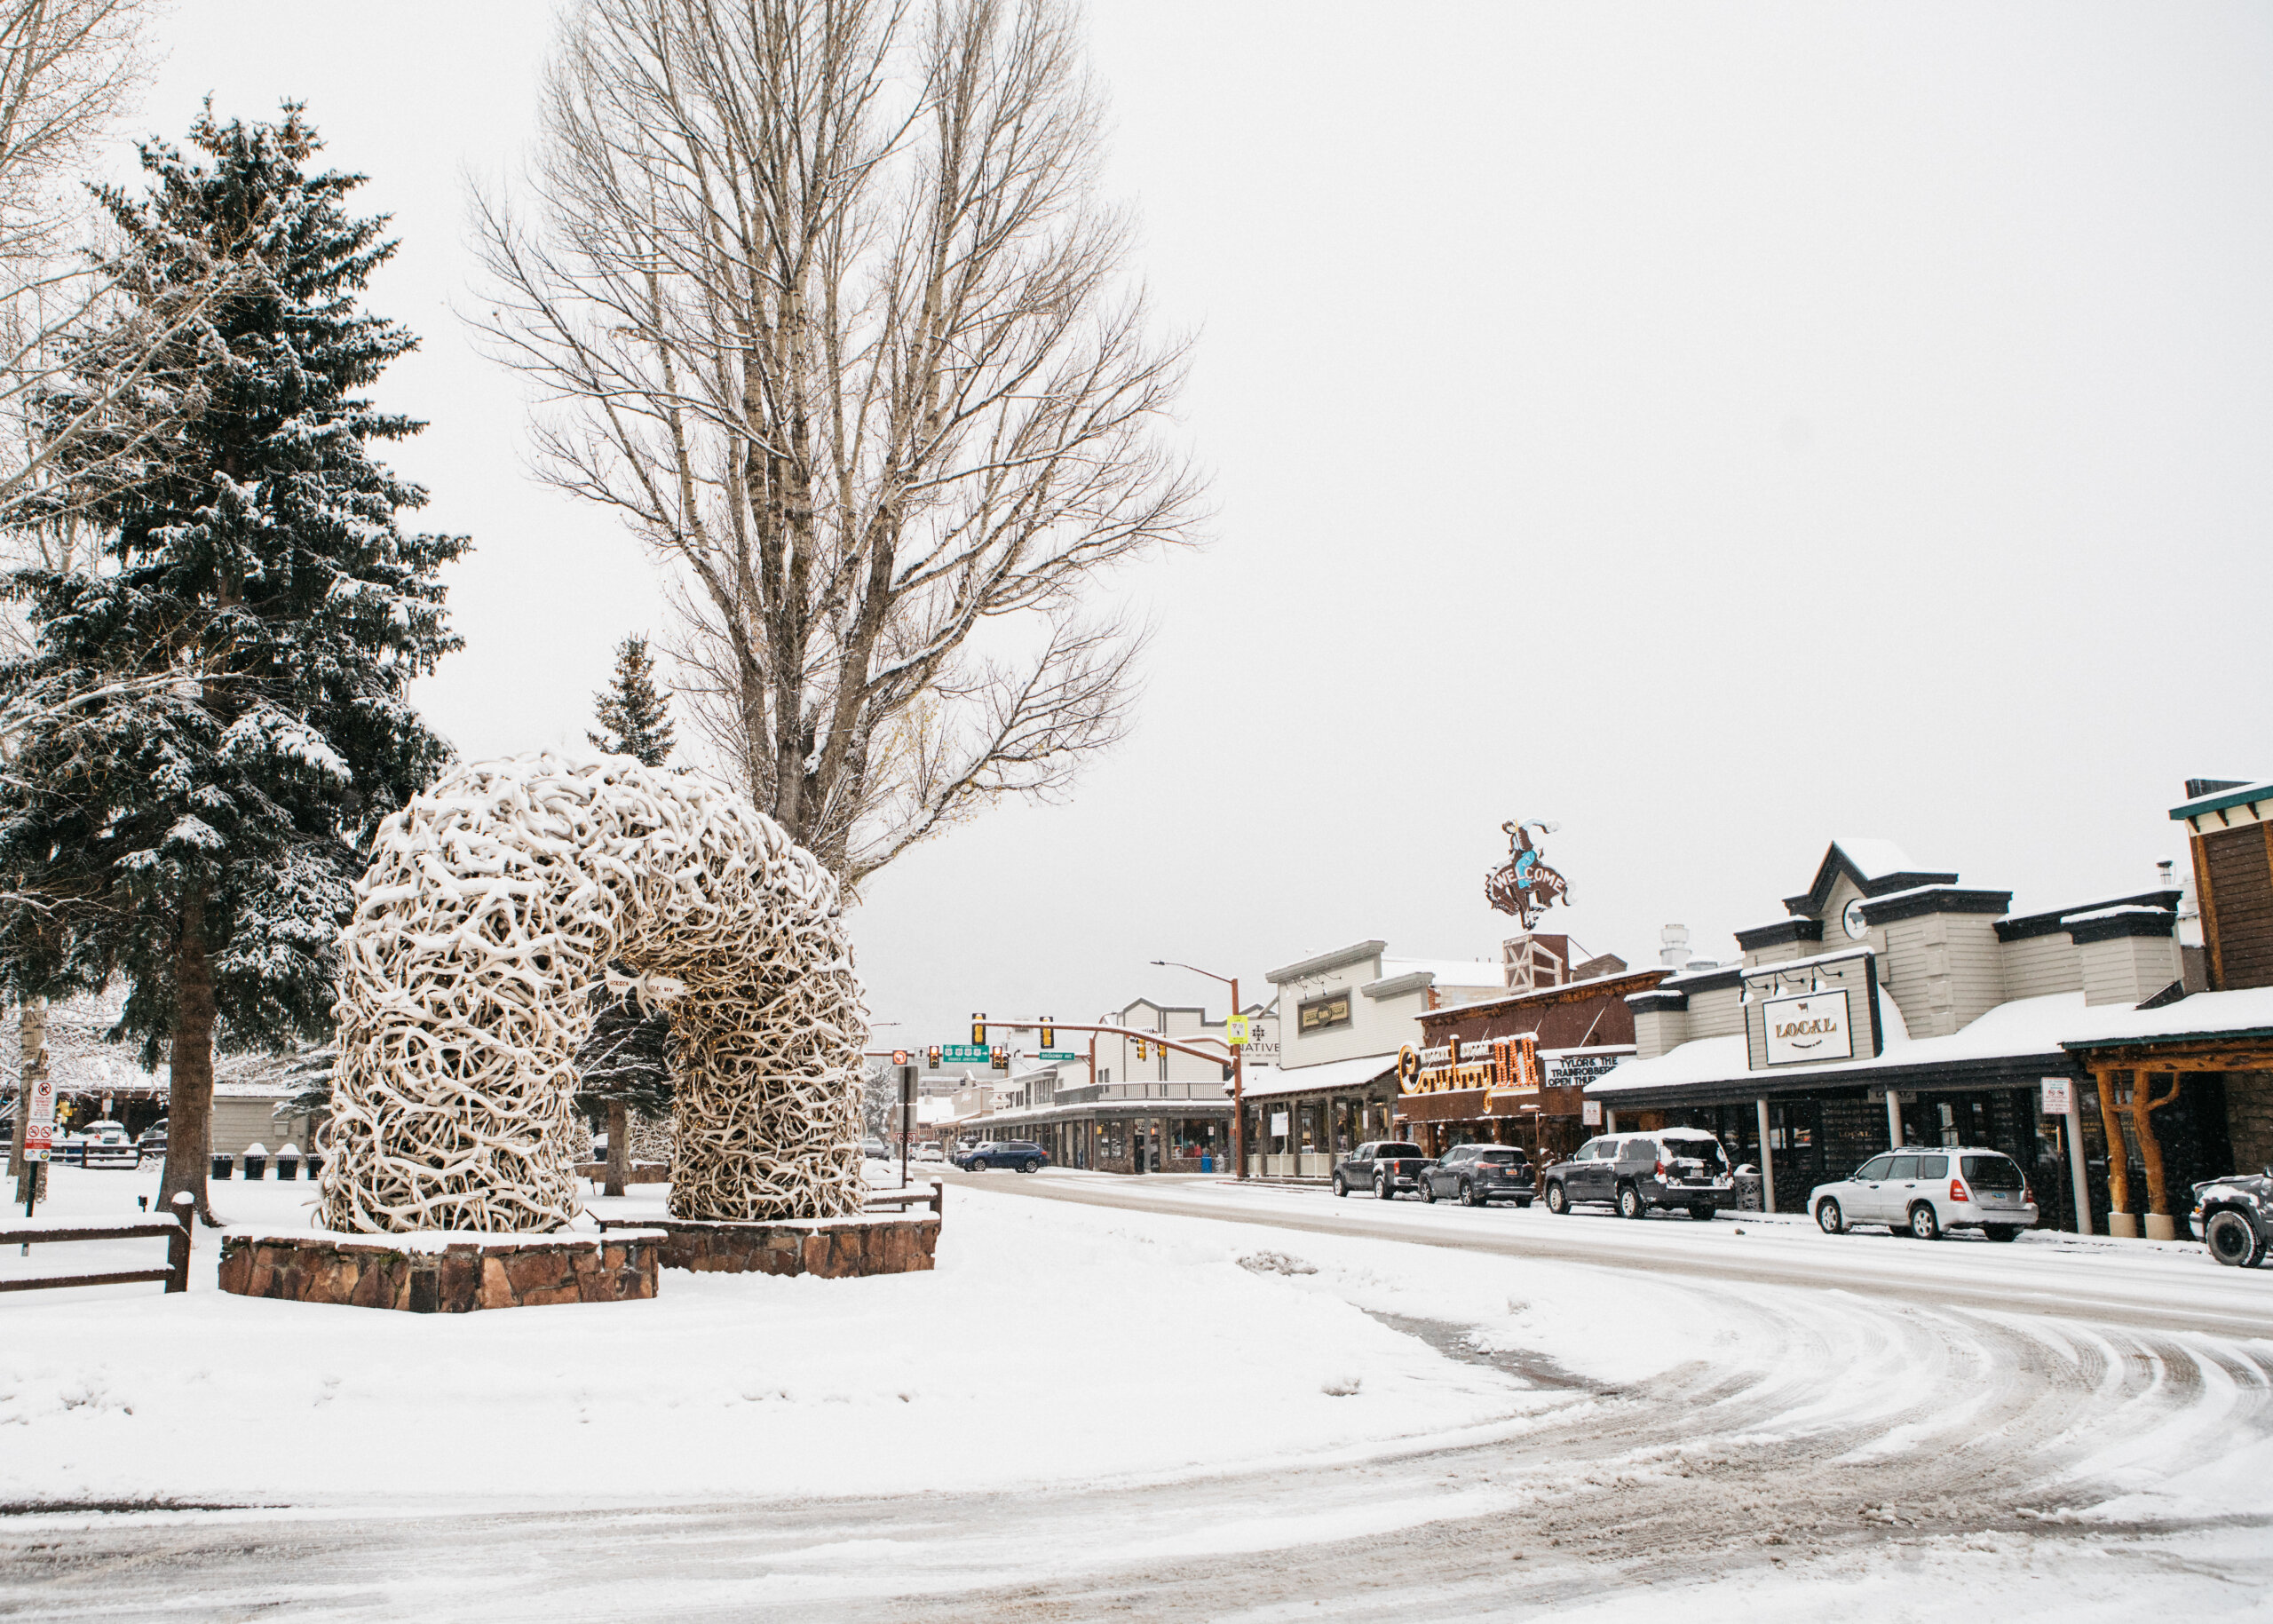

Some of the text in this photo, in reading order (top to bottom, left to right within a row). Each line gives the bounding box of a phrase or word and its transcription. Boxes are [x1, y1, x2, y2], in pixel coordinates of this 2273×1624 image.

[1493, 867, 1566, 894] WELCOME
[1776, 1017, 1837, 1039] LOCAL
[1493, 1036, 1538, 1088] BAR
[1601, 1056, 1618, 1066] THE
[1548, 1077, 1572, 1087] OPEN
